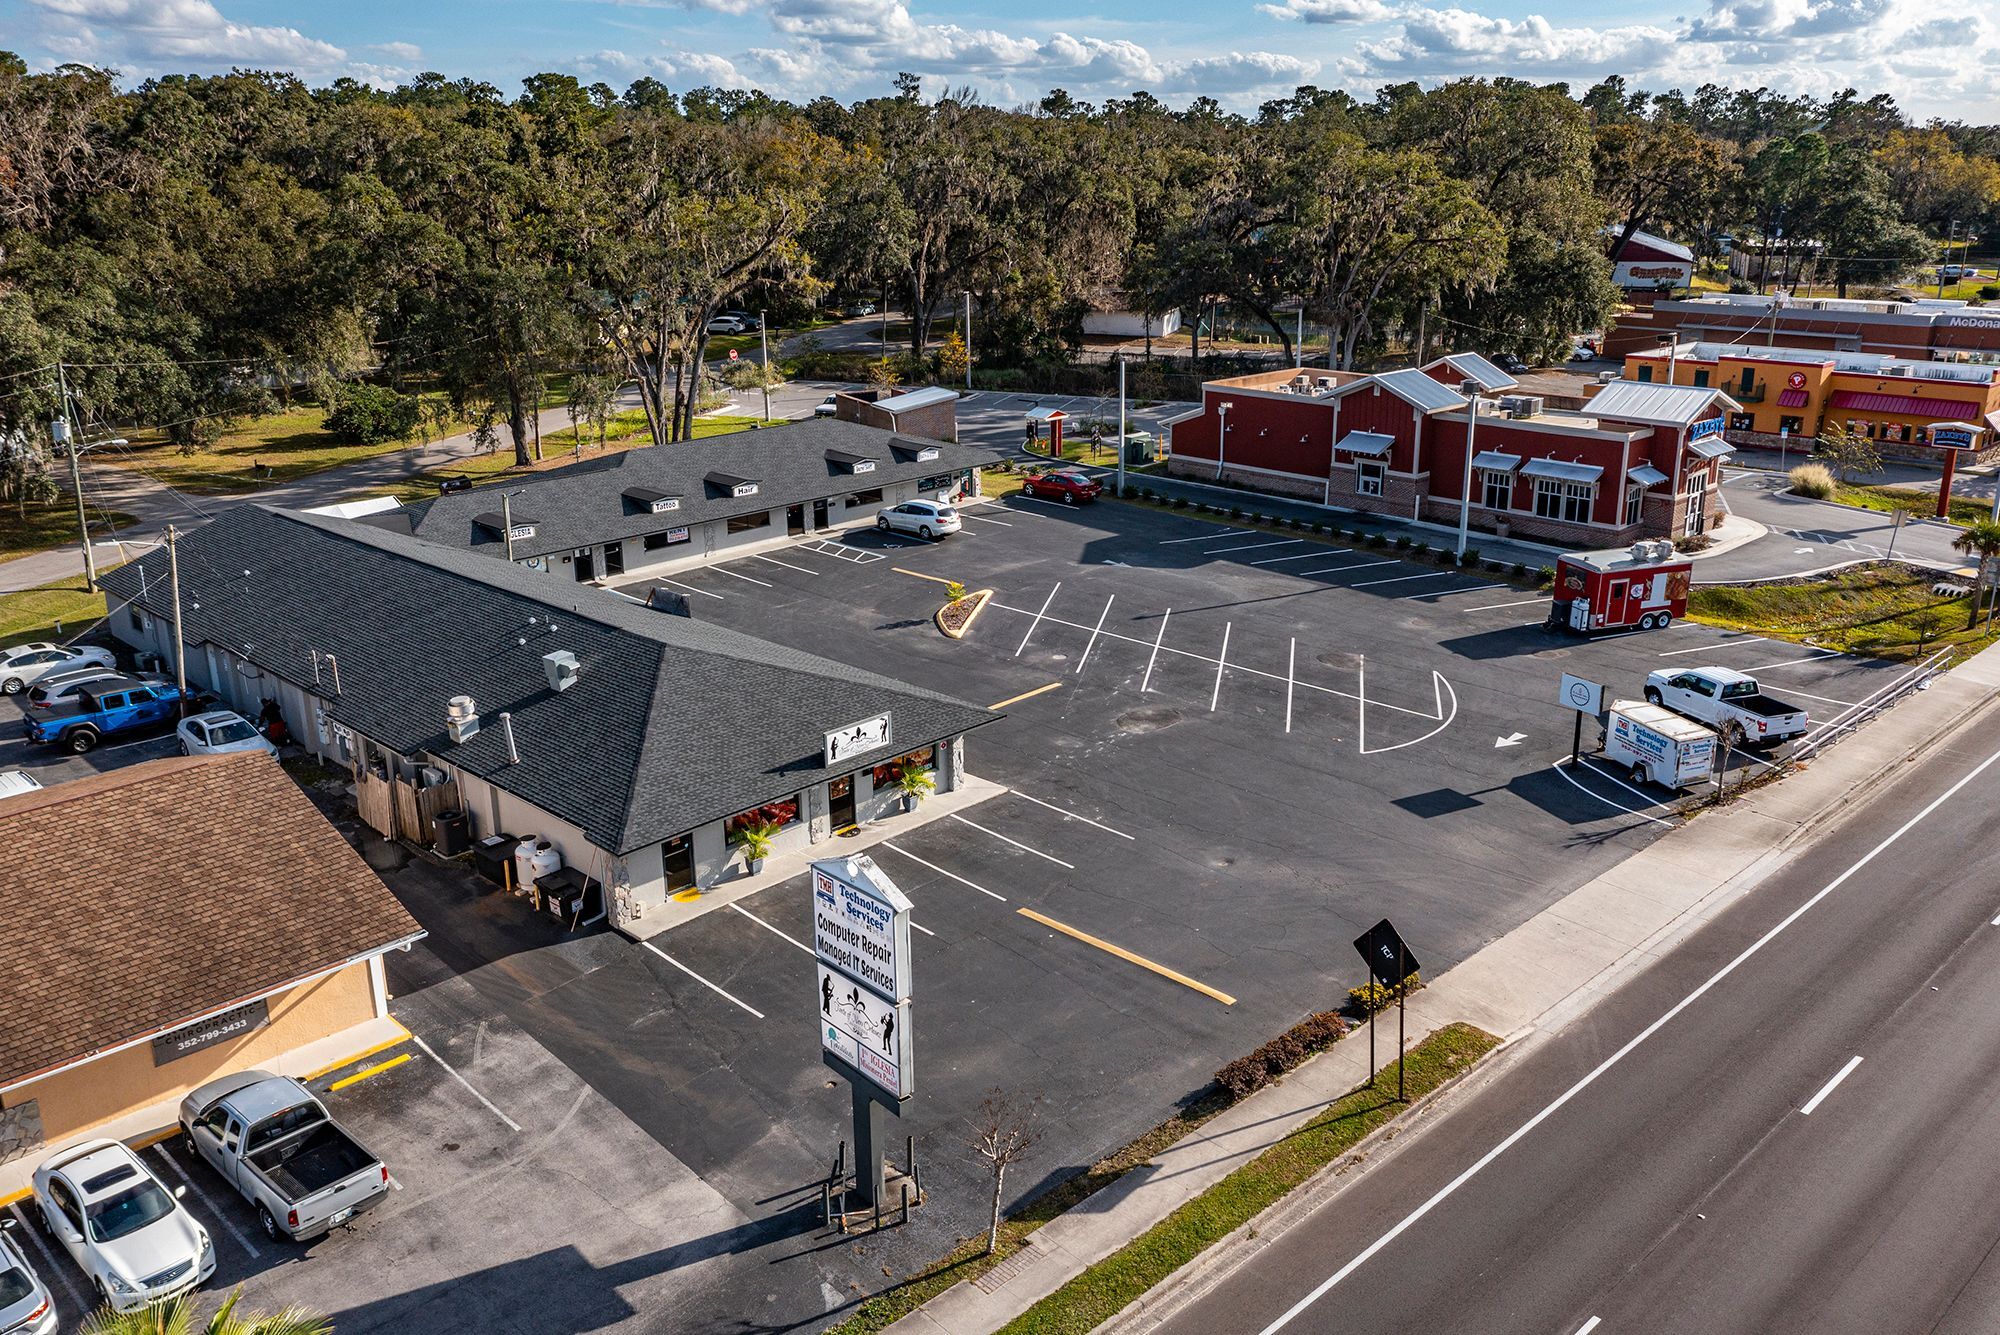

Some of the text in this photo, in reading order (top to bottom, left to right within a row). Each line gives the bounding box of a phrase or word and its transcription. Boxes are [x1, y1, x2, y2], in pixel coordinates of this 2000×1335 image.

[738, 486, 753, 495] Hair
[656, 502, 677, 511] Tattoo
[1632, 724, 1668, 748] Technology
[1636, 735, 1662, 753] Services
[819, 877, 832, 894] TMH
[839, 884, 891, 922] Technology
[846, 902, 884, 931] Services
[818, 913, 891, 965] Computer Repair
[818, 935, 893, 992] Managed IT Services
[1381, 944, 1394, 959] TCP
[166, 1007, 256, 1045] CHIROPRACTIC
[178, 1019, 247, 1050] 352-799-3433
[870, 1054, 895, 1078] IGLESIA
